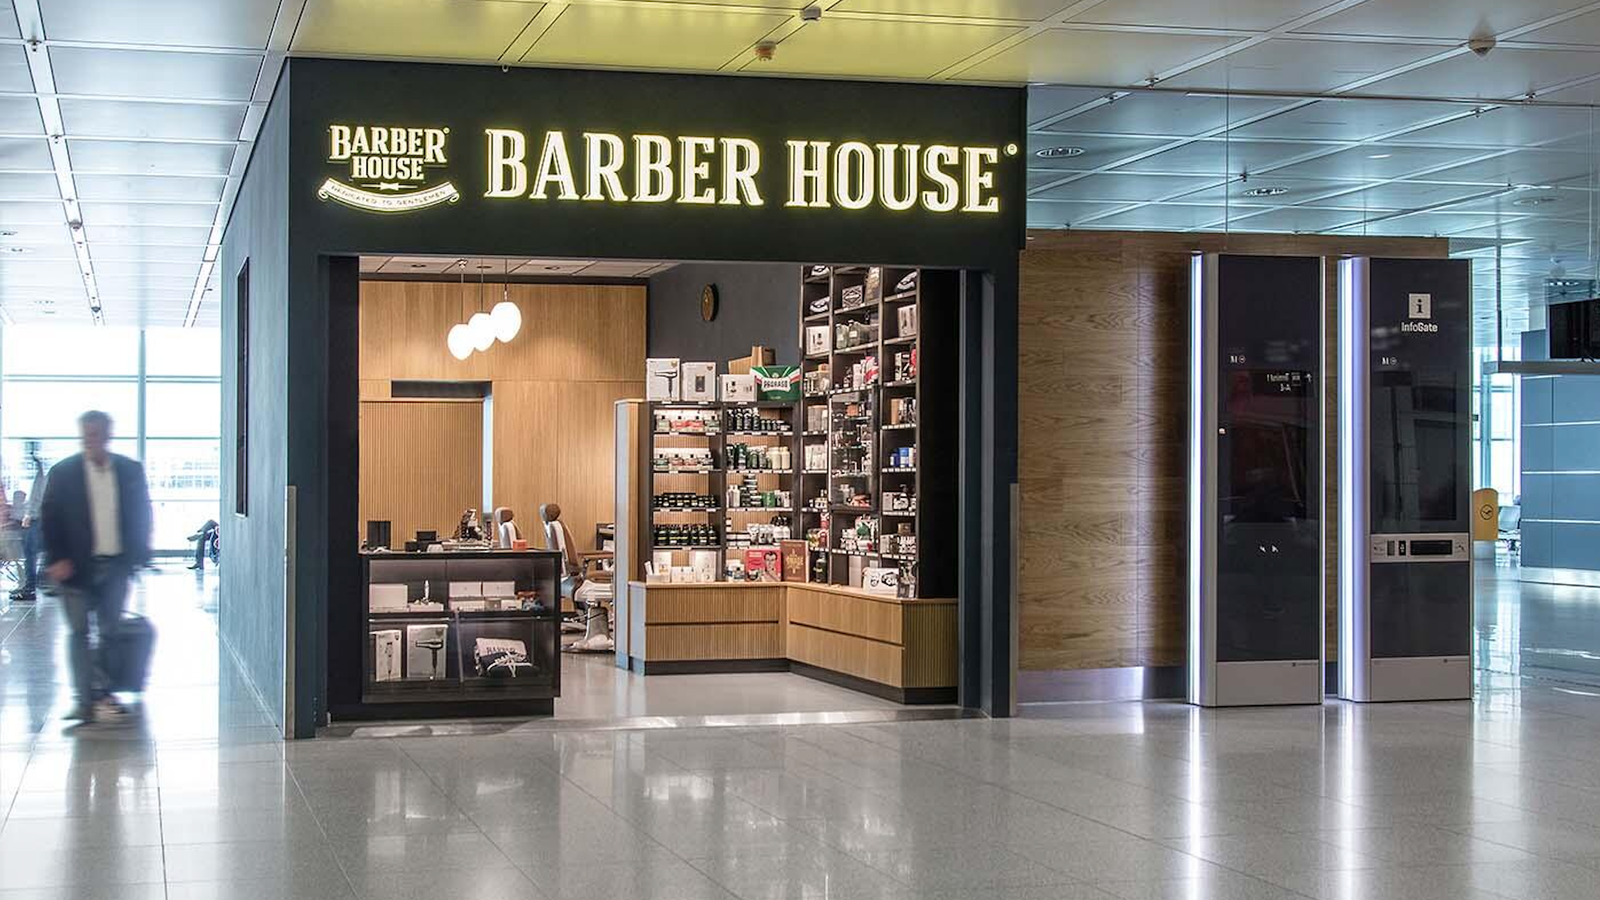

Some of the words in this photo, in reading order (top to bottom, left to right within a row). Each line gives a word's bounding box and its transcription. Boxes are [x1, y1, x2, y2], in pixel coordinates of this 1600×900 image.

[328, 125, 447, 163] BARBER
[351, 156, 424, 180] HOUSE
[484, 128, 764, 206] BARBER
[785, 139, 999, 213] HOUSE
[1401, 321, 1438, 332] InfoGate
